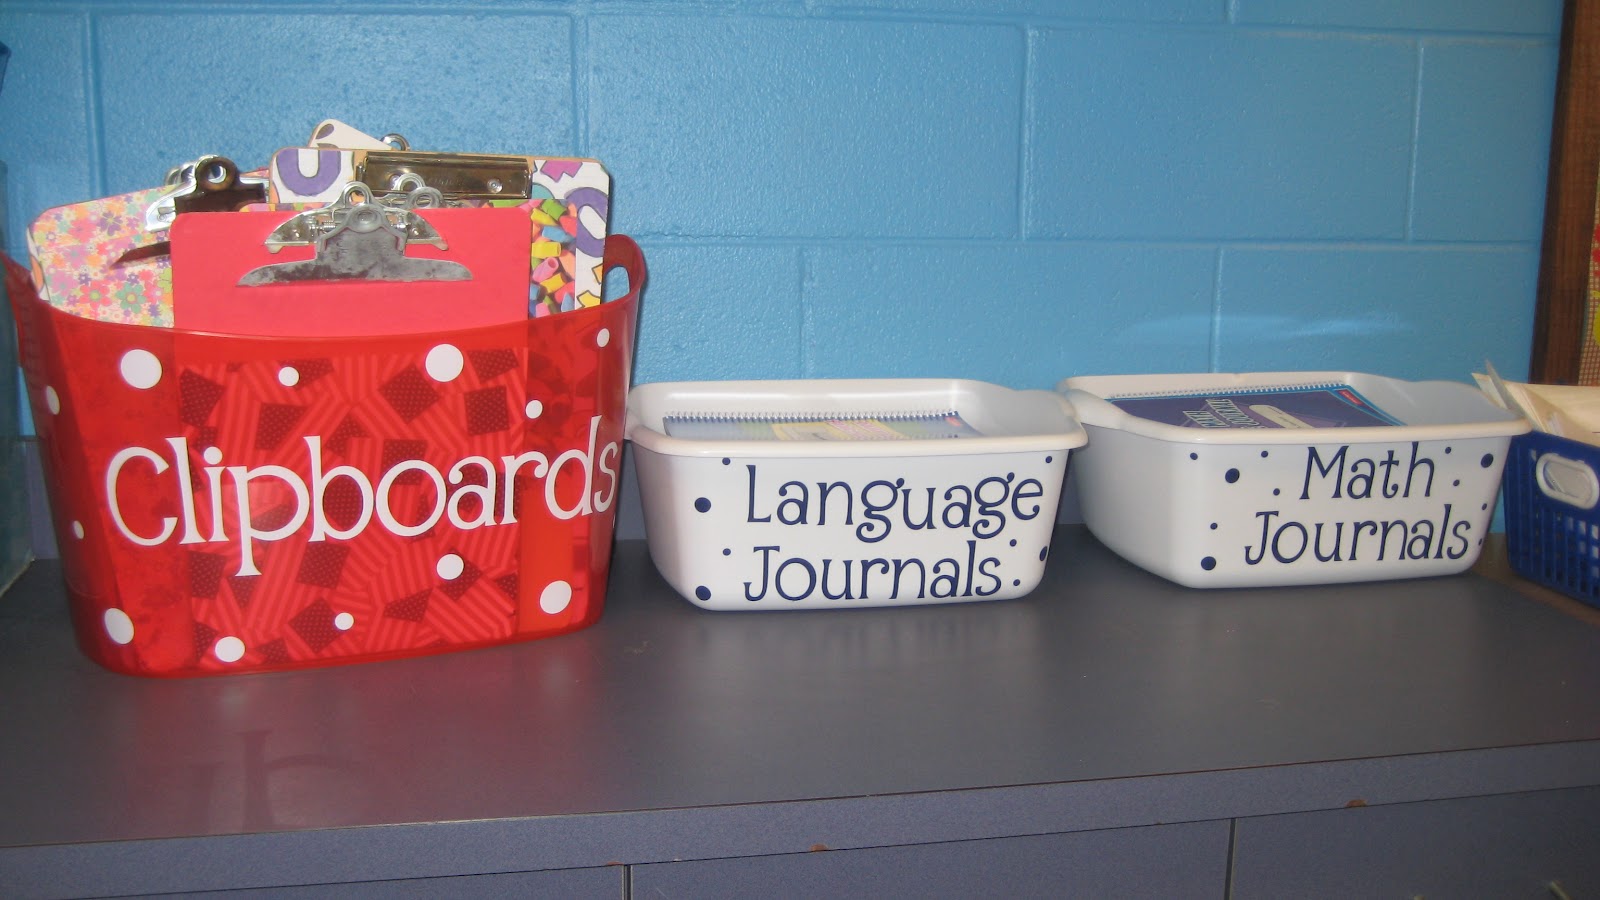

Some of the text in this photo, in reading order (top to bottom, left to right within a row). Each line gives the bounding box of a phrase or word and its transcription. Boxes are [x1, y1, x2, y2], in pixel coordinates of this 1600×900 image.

[106, 415, 618, 577] Clipboards
[1300, 442, 1434, 500] Math
[745, 464, 1043, 543] Language
[1245, 504, 1469, 565] Journals
[744, 540, 1002, 602] Journals
